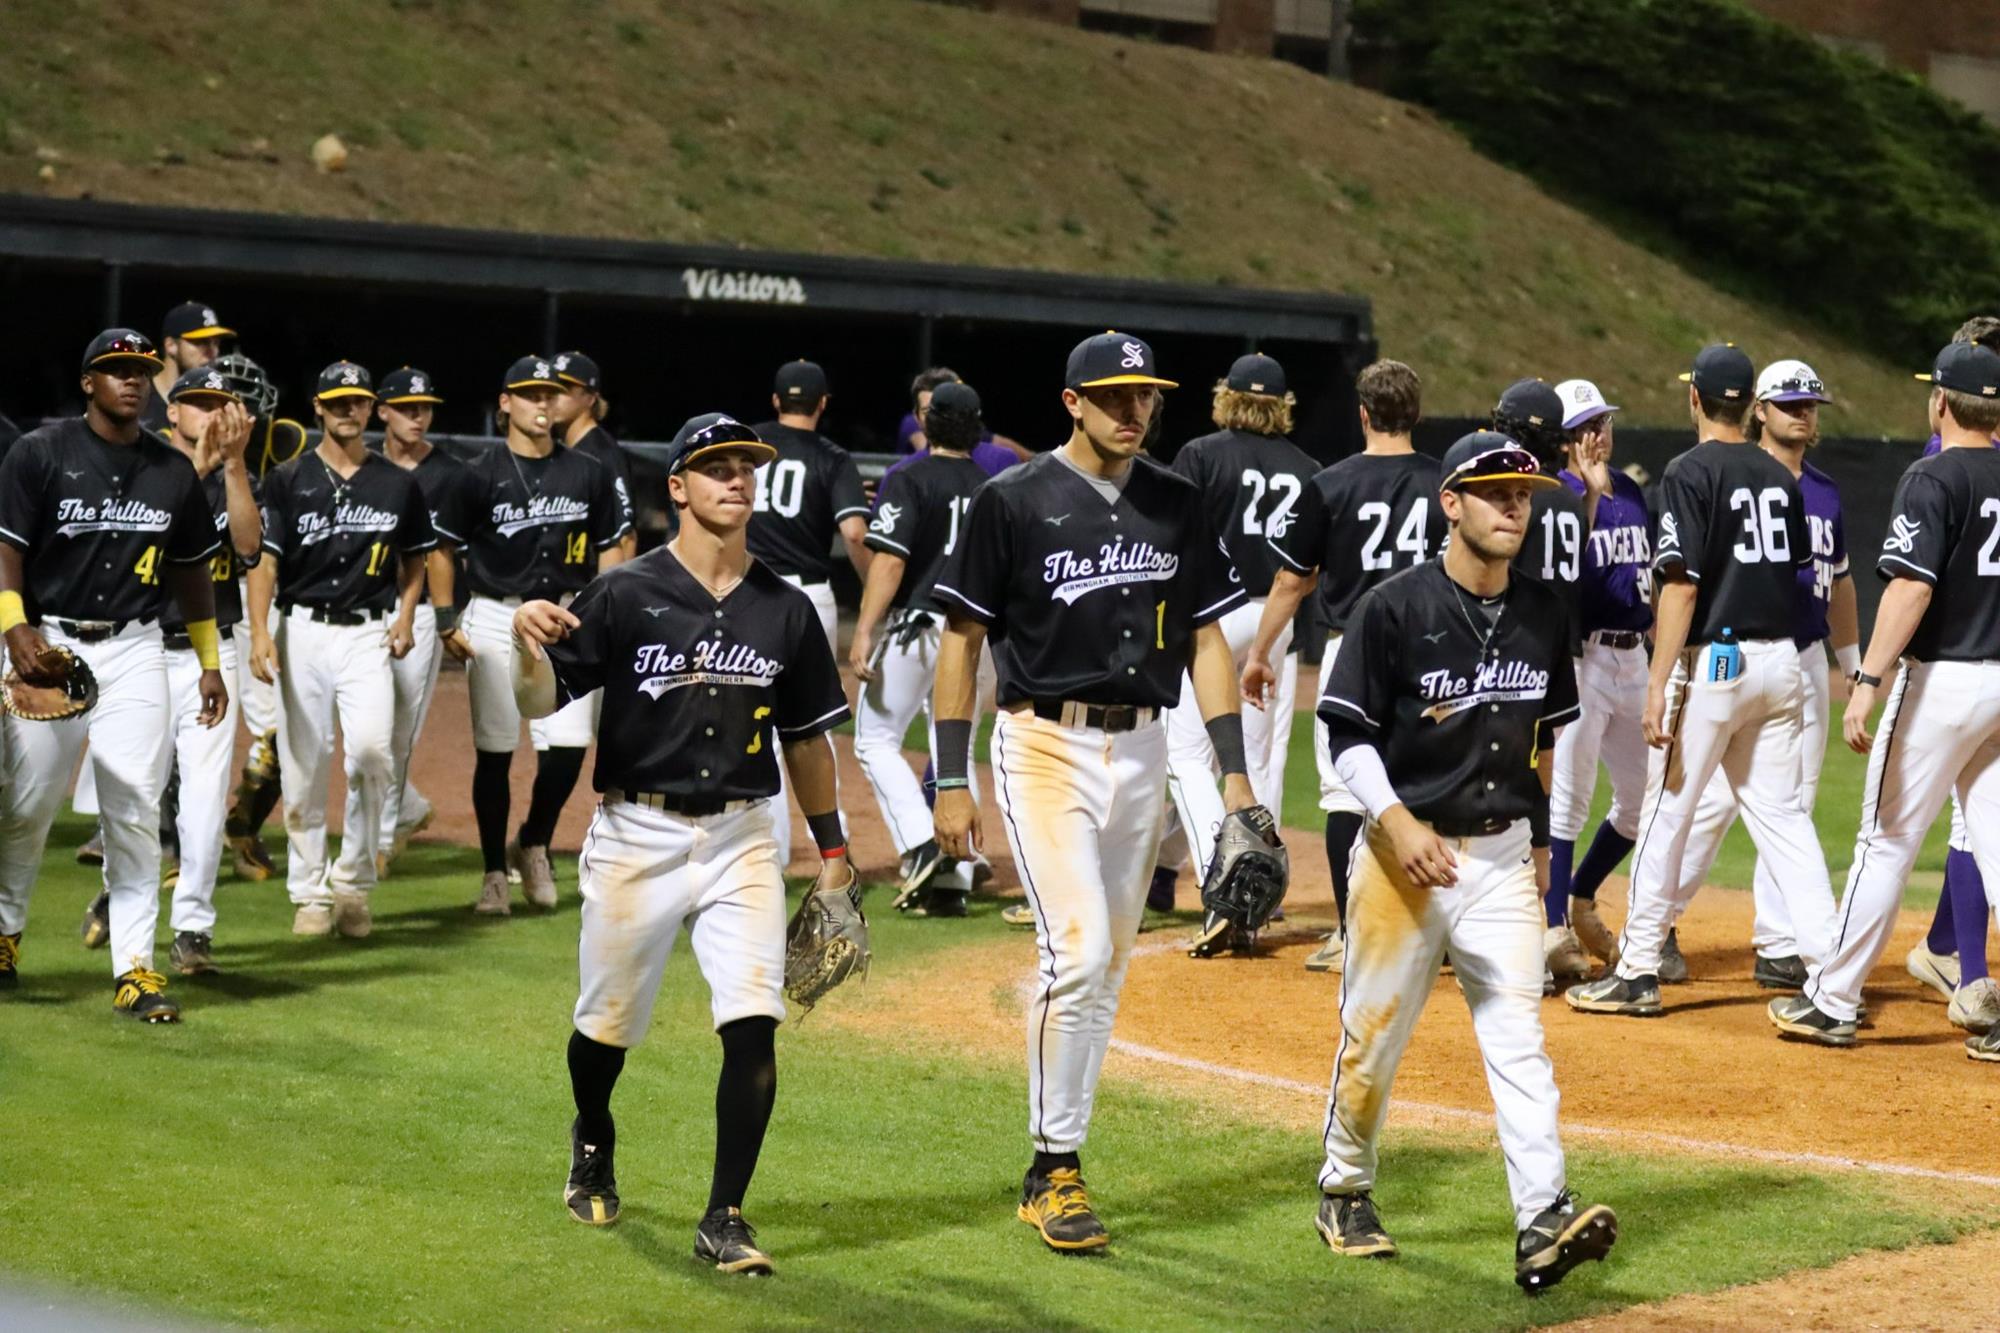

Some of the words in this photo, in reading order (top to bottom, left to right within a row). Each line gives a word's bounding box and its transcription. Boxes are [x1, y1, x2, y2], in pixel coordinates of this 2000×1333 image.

[682, 267, 807, 304] Visitors
[57, 498, 97, 522] The
[491, 502, 525, 523] The
[1241, 468, 1303, 539] 22
[1357, 496, 1429, 572] 24
[1541, 507, 1580, 584] 19
[1585, 525, 1651, 568] TIGERS
[1730, 486, 1792, 565] 36
[564, 531, 588, 564] 14
[1043, 549, 1095, 583] The
[1099, 542, 1178, 574] Hilltop
[1155, 600, 1167, 649] 1
[633, 643, 687, 674] The
[692, 640, 784, 678] Hilltop
[1420, 668, 1469, 700] The
[1473, 658, 1549, 692] Hilltop
